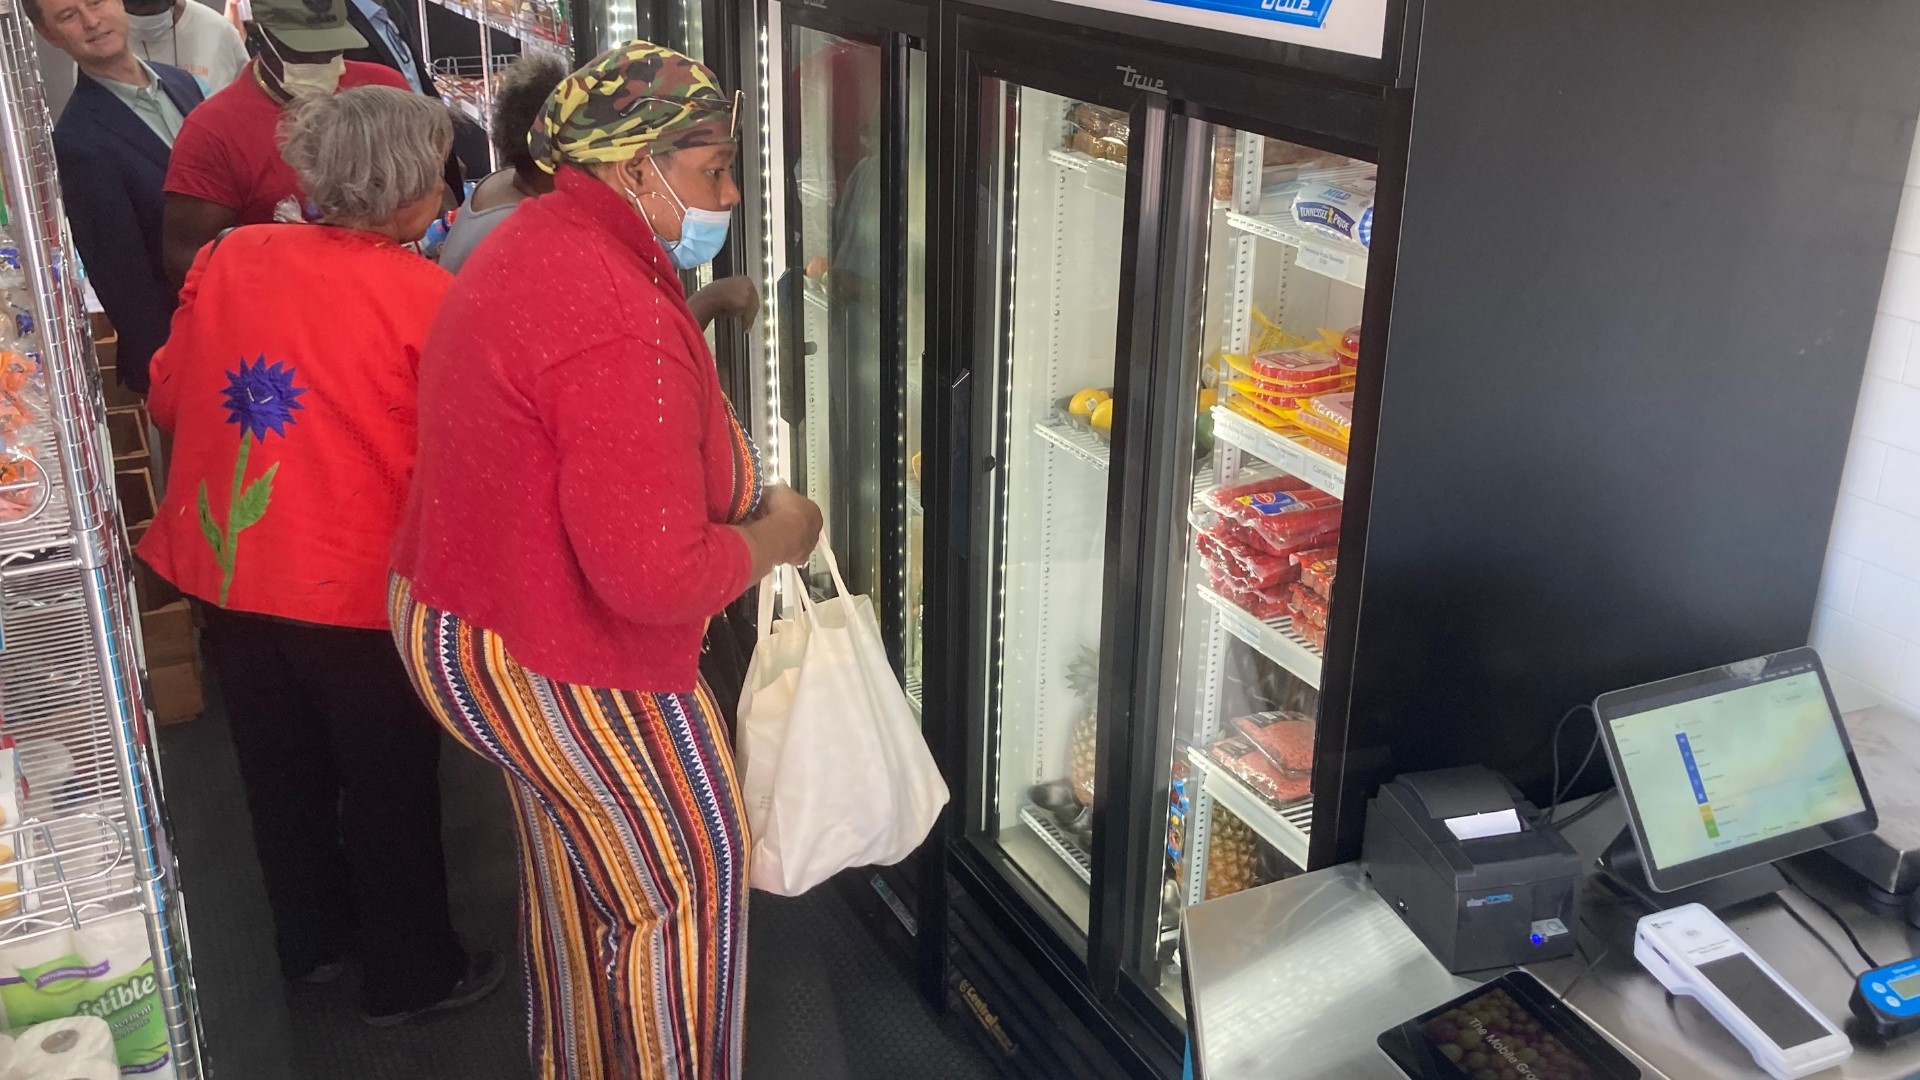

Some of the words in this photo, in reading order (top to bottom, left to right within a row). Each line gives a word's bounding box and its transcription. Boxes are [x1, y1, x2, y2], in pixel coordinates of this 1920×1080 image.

[1323, 188, 1351, 201] MILD
[1300, 206, 1329, 220] TENNESSEE
[1333, 213, 1350, 232] PRIDE
[1312, 465, 1333, 482] Carolina
[1468, 1017, 1488, 1035] The
[1485, 1033, 1518, 1064] Mobile
[1516, 1062, 1541, 1080] Gro
